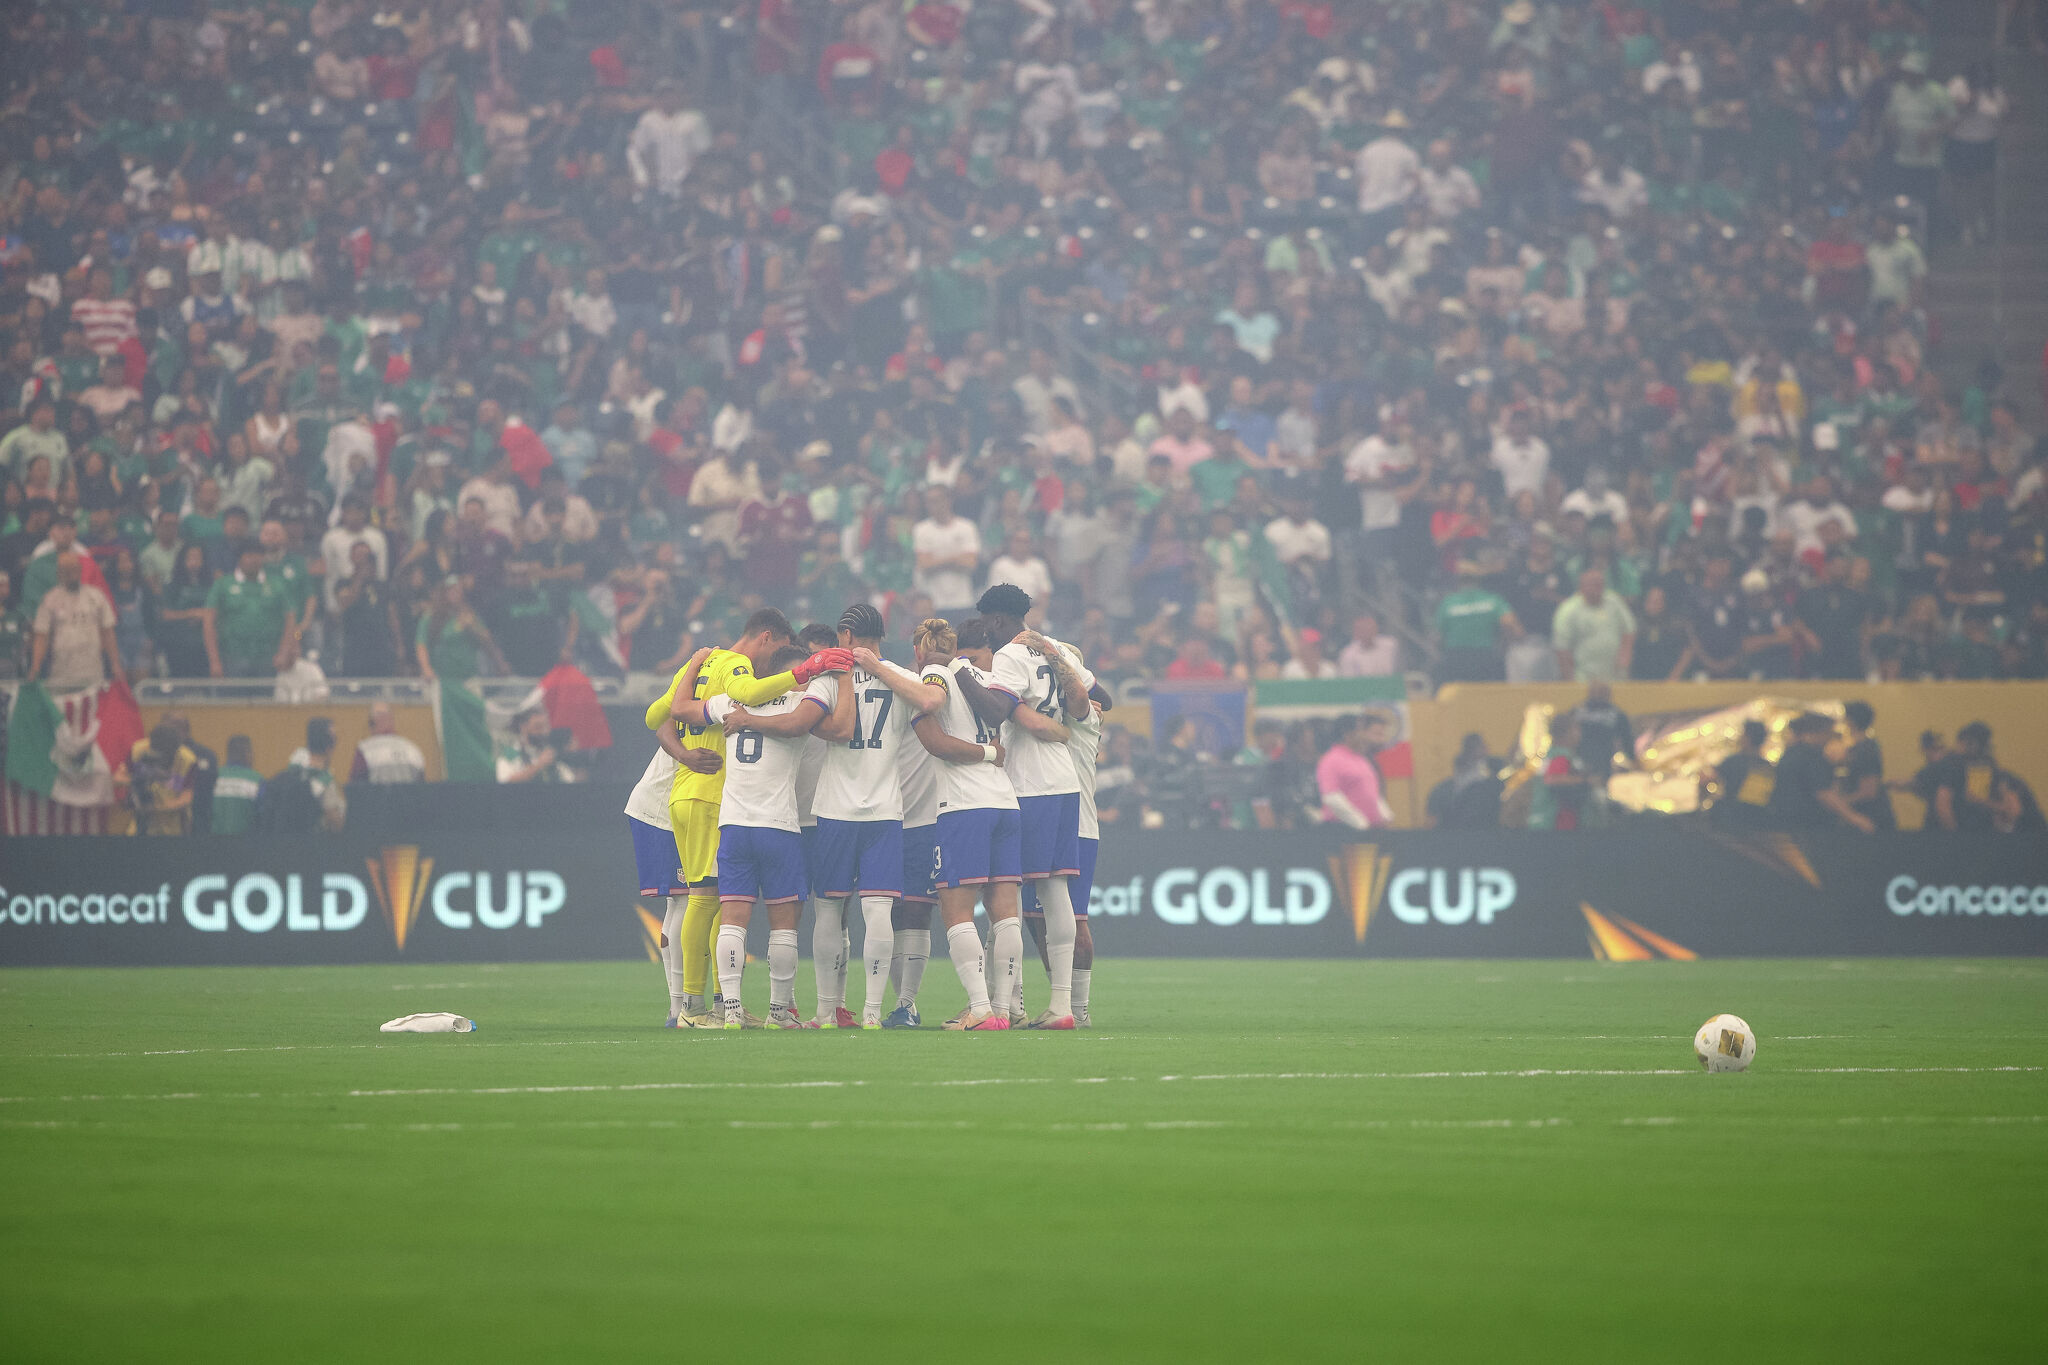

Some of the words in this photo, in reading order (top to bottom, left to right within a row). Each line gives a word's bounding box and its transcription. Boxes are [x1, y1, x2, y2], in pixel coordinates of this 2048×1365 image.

[849, 688, 893, 750] 17
[0, 883, 171, 924] oncacaf
[182, 874, 368, 932] GOLD
[432, 871, 566, 928] CUP
[1152, 868, 1331, 925] GOLD
[1388, 868, 1517, 925] CUP
[1886, 875, 2048, 917] Concaca
[1007, 957, 1015, 976] USA
